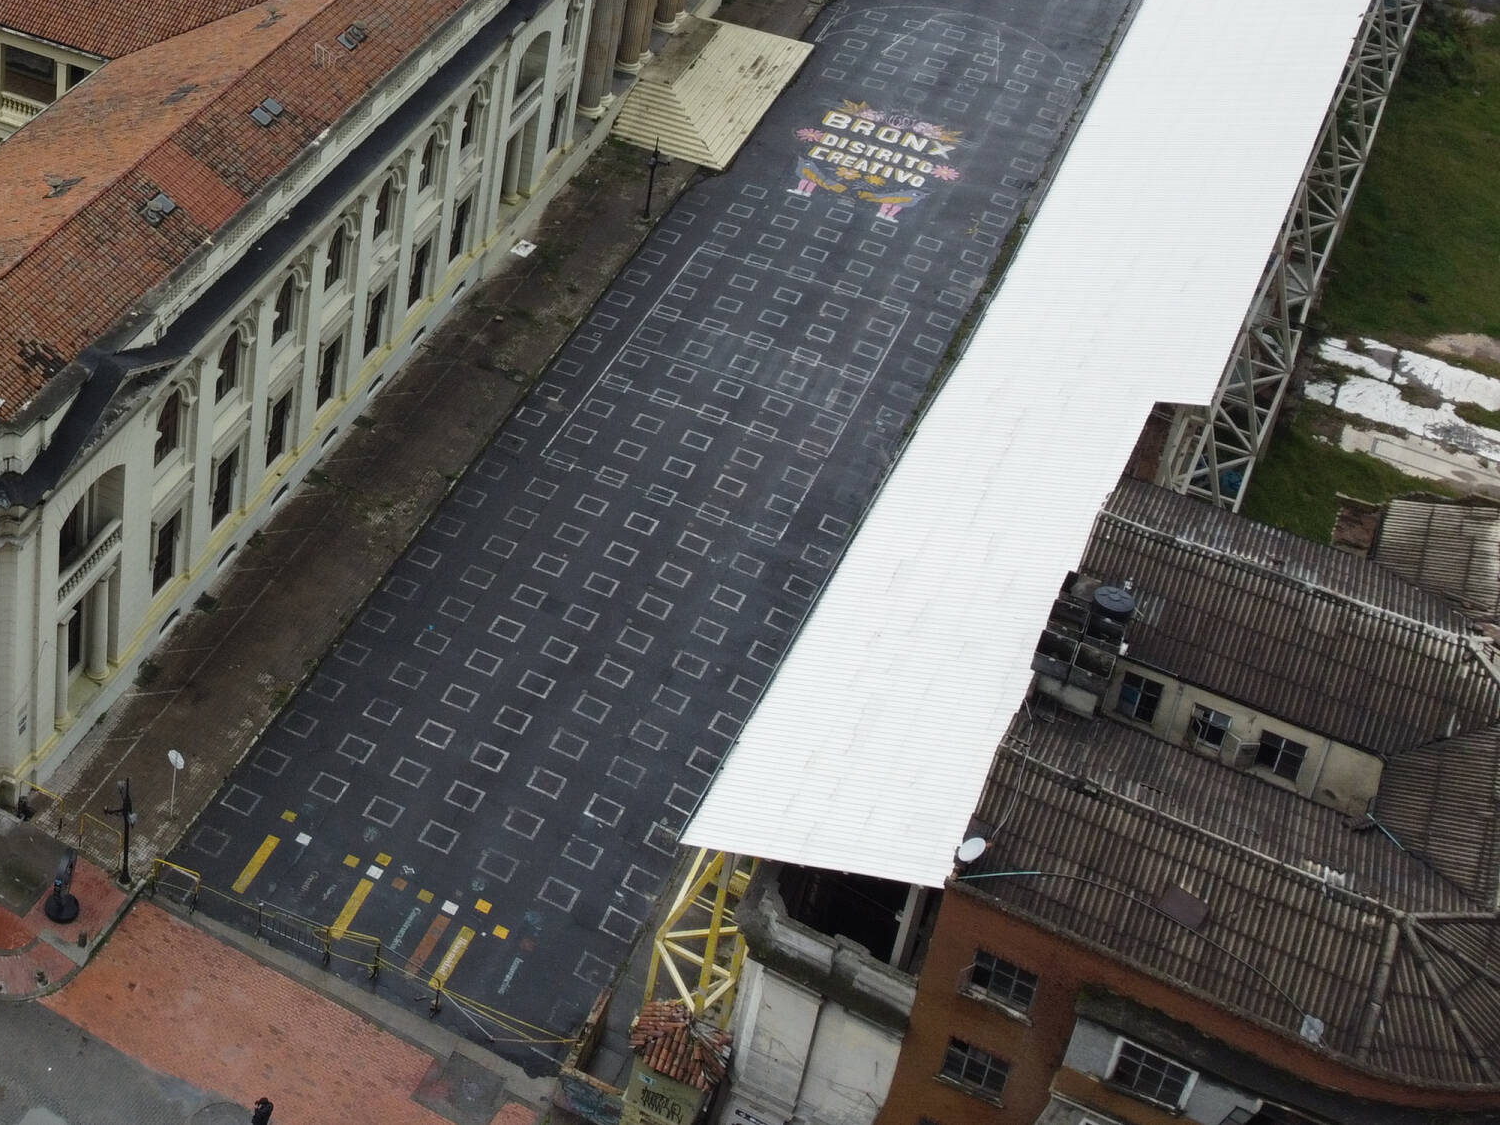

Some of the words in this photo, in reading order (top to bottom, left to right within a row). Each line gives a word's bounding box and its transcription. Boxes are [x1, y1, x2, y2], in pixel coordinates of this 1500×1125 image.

[820, 132, 934, 174] DISTRITO
[822, 110, 957, 160] BRONX
[808, 145, 926, 188] CREATIVO
